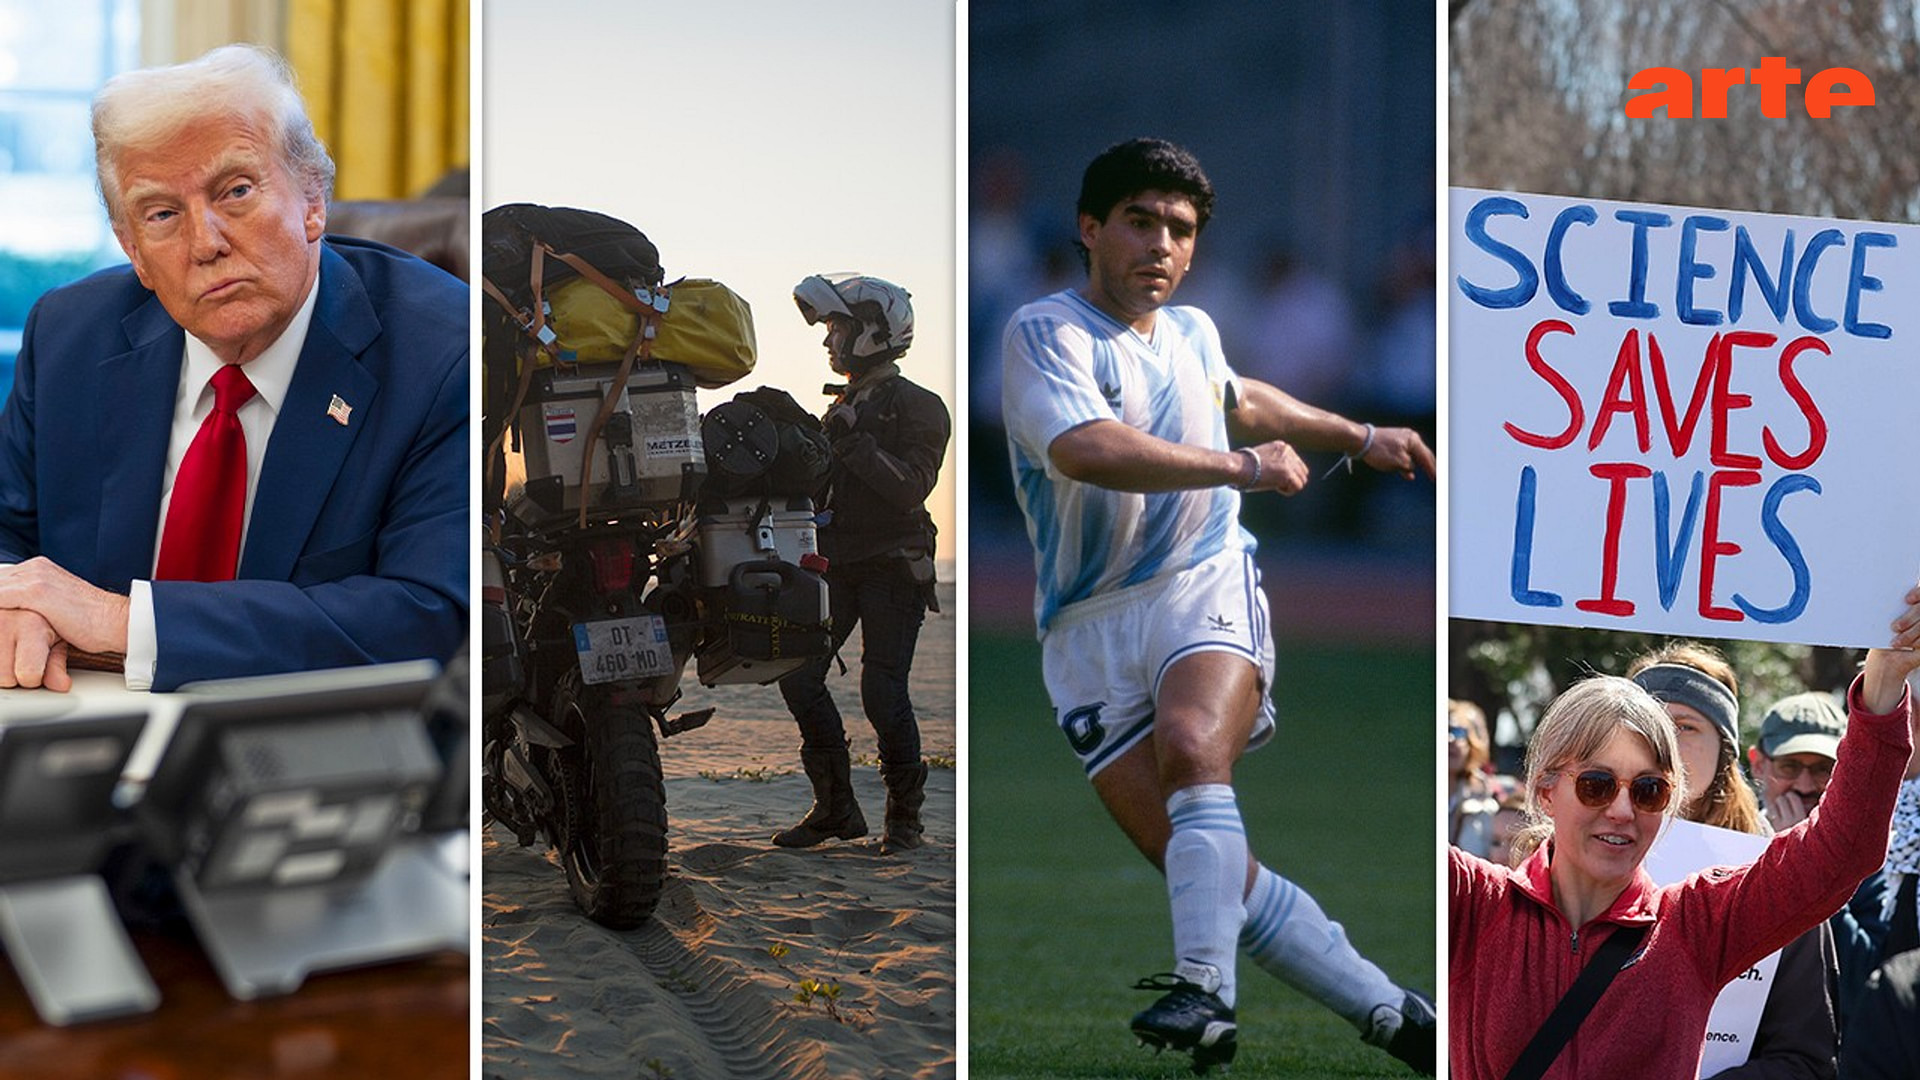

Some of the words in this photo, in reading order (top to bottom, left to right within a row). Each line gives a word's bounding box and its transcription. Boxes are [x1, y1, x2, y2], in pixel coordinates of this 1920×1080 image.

[1456, 196, 1897, 340] SCIENCE
[1503, 319, 1832, 471] SAVES
[1510, 463, 1823, 625] LIVES
